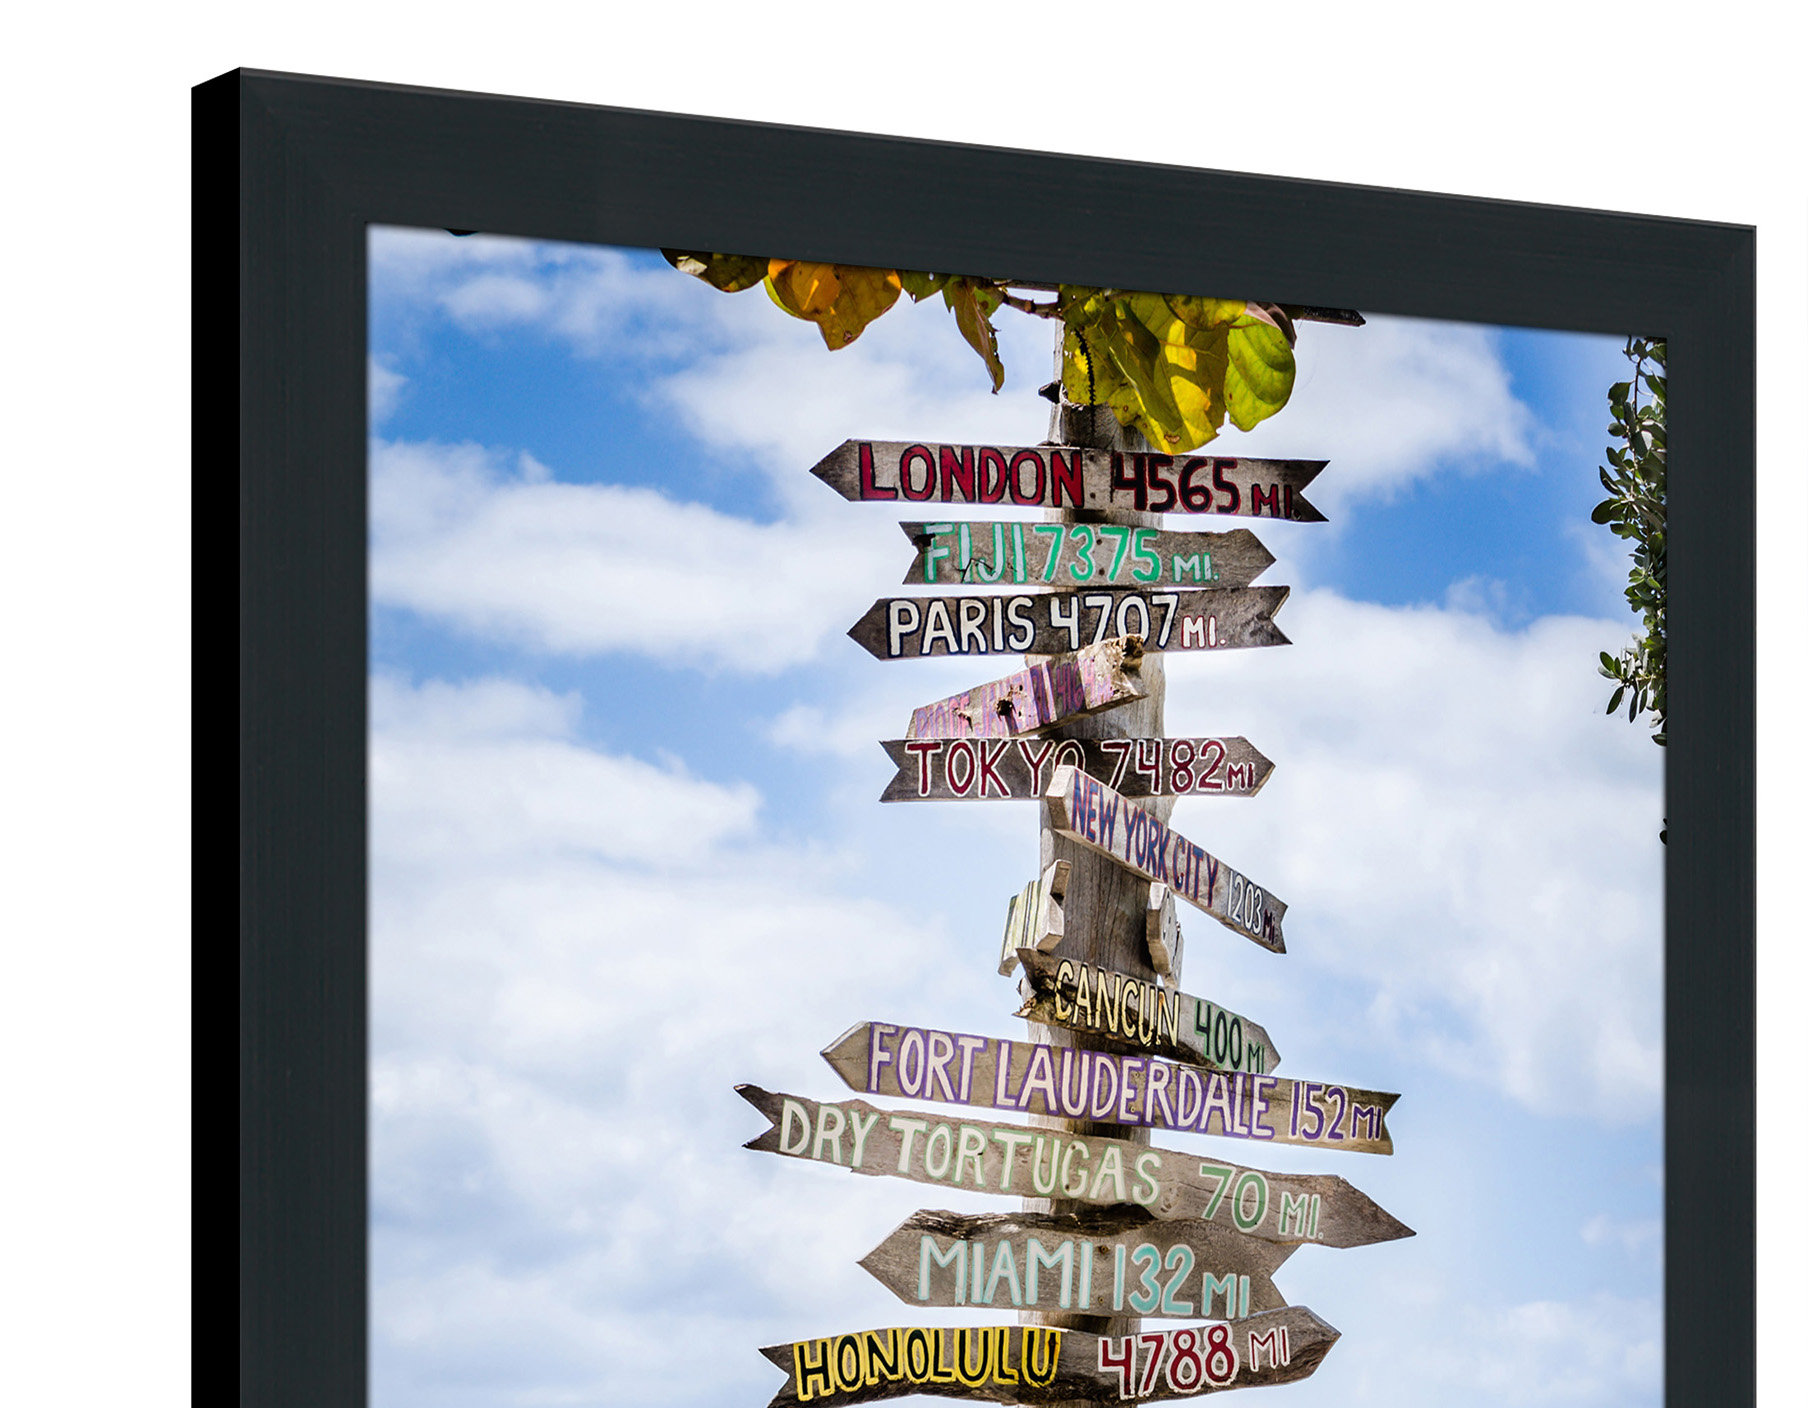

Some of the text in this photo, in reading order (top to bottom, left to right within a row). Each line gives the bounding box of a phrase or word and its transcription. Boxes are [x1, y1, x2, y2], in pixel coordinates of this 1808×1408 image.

[859, 443, 1086, 508] LONDON
[1112, 452, 1241, 514] 4565
[923, 522, 1220, 583] FIJI 7375 MI.
[888, 592, 1227, 658] PARIS 4707 MI.
[1100, 739, 1228, 797] 7482
[1227, 761, 1254, 790] MI
[1071, 768, 1120, 852] NEW
[1123, 799, 1171, 883] YORK
[1172, 835, 1219, 908] CITY
[1227, 869, 1263, 936] 1203
[1054, 959, 1265, 1075] CANCUN 400 MI
[867, 1021, 1384, 1142] FORT LAUDERDALE 152 MI
[778, 1099, 1324, 1239] DRY TORTUGAS 70 MI.
[916, 1234, 1251, 1320] MIAMI 132 MI
[793, 1321, 1291, 1401] HONOLULU 4788 MI
